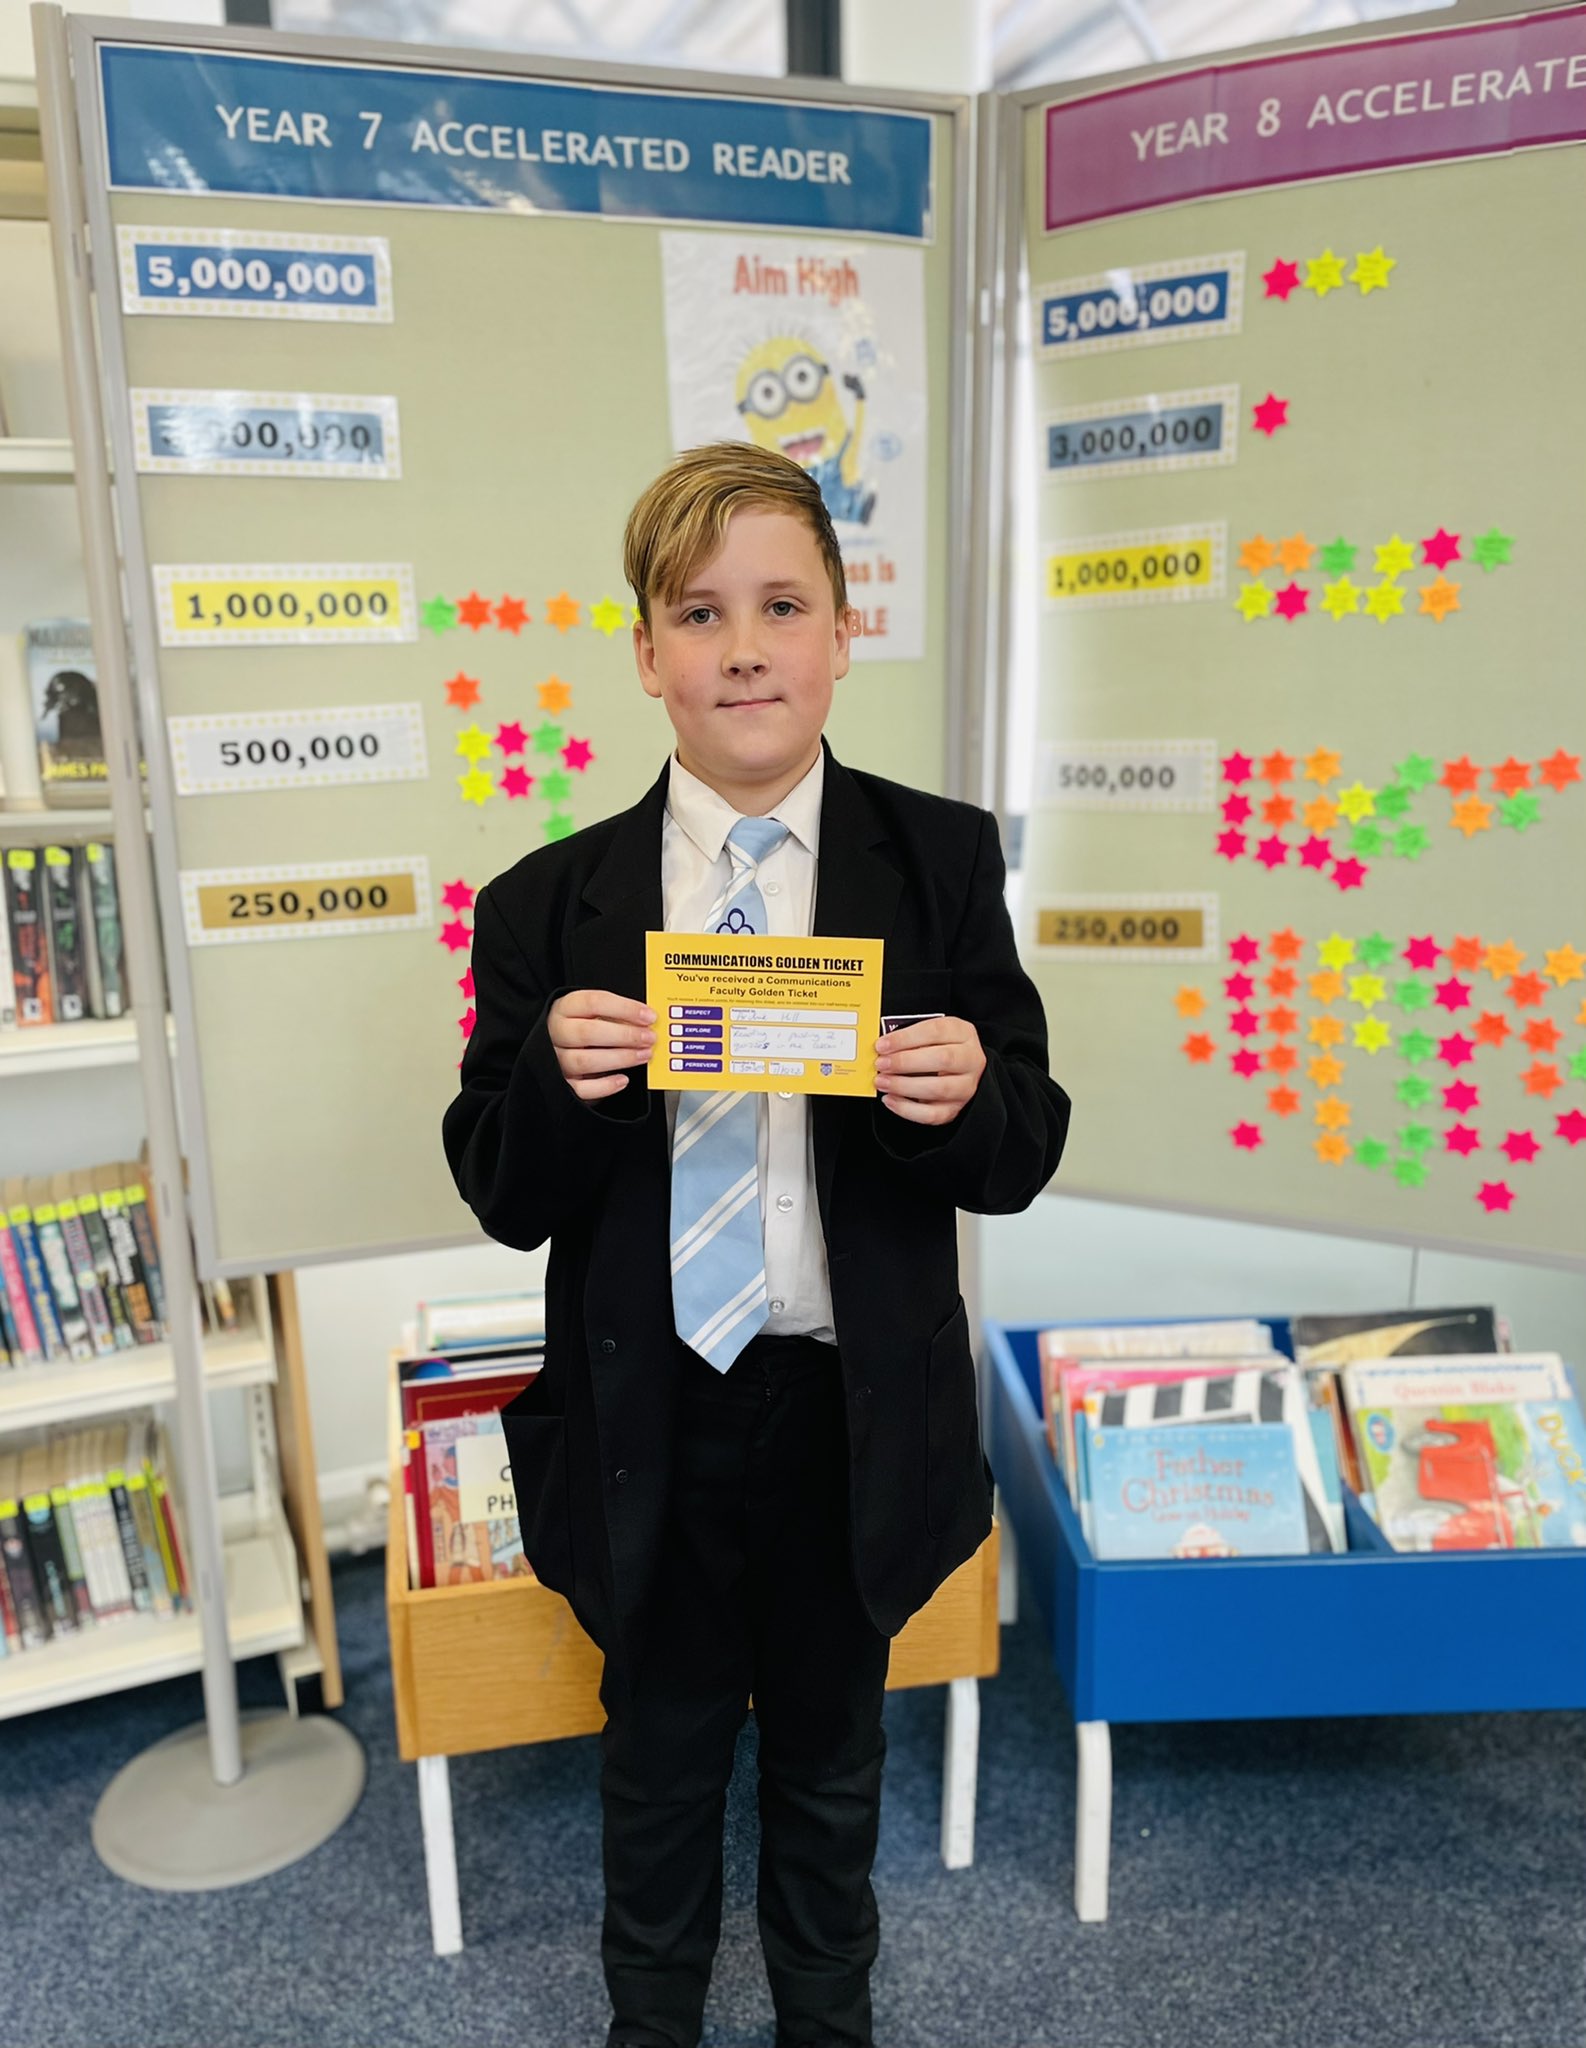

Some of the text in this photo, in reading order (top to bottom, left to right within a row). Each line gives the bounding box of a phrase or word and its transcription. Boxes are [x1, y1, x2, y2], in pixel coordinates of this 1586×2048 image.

[1130, 53, 1586, 161] YEAR 8 ACCELERATE
[215, 104, 852, 185] YEAR 7 ACCELERATED READER
[148, 256, 366, 300] 5,000,000
[733, 254, 859, 307] Aim High
[1047, 281, 1220, 341] 5,000,000
[1053, 414, 1213, 462] 3,000,000
[1053, 552, 1201, 592] 1,000,000
[187, 591, 389, 626] 1,000,000
[220, 733, 380, 769] 500,000
[1059, 764, 1176, 795] 500,000
[228, 885, 388, 921] 250,000
[1055, 917, 1179, 946] 250,000
[664, 952, 864, 971] COMMUNICATIONS GOLDEN TICKET
[676, 973, 710, 983] You've
[712, 975, 755, 984] received
[766, 976, 851, 987] Communications
[709, 986, 818, 998] Faculty Golden Ticket
[1149, 1446, 1245, 1481] Father
[1122, 1477, 1275, 1514] Christmas
